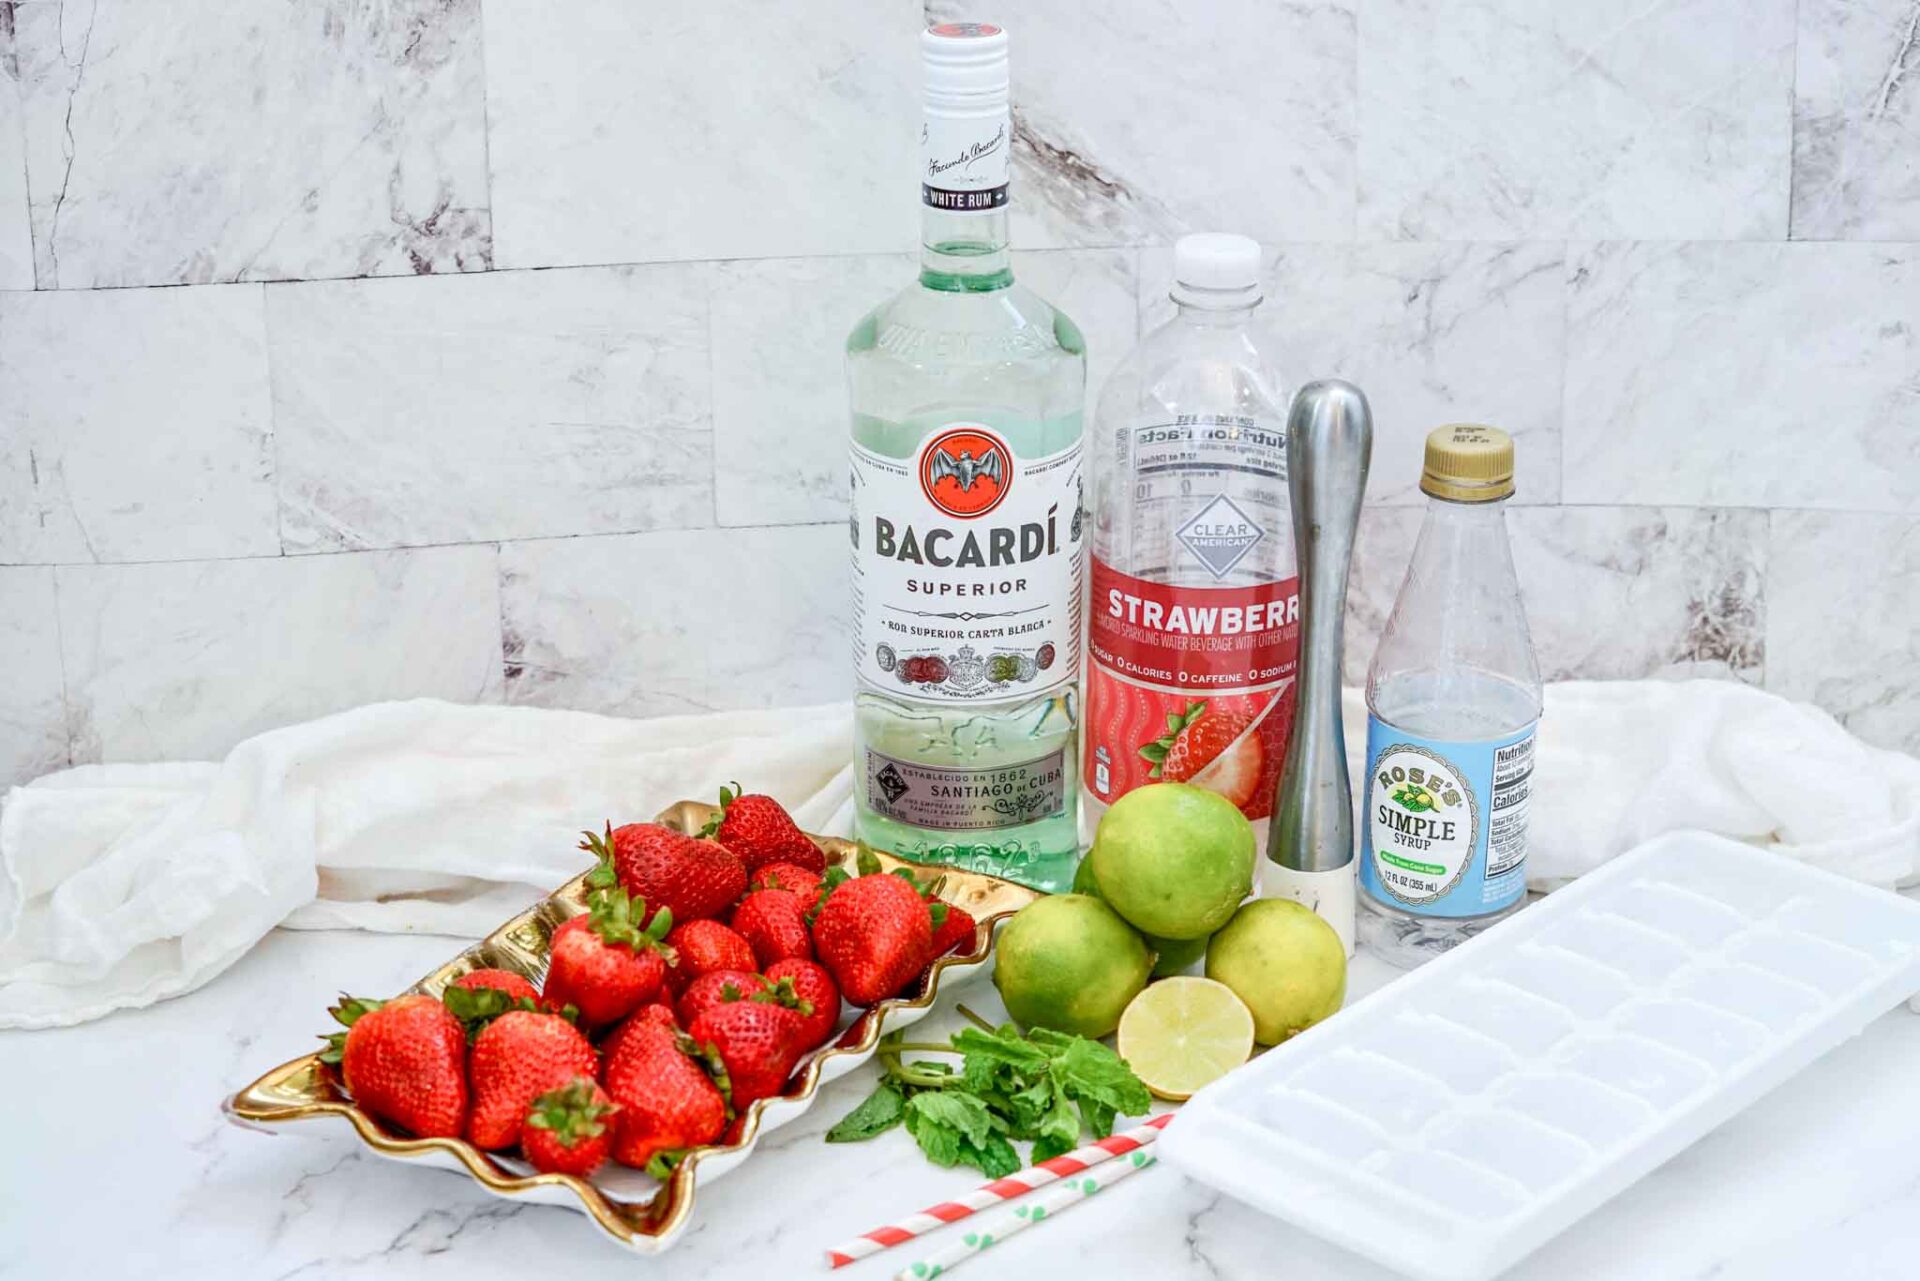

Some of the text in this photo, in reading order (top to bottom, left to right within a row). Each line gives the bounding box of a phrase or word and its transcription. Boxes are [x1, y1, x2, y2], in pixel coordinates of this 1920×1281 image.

[930, 189, 992, 207] WHITE RUM
[876, 501, 1058, 568] BACARDÍ
[1194, 524, 1248, 536] CLEAR
[906, 578, 1028, 596] SUPERIOR
[910, 626, 965, 640] SUPERIOR
[968, 627, 1004, 639] CARTA
[1008, 621, 1045, 637] BLANCA
[1121, 623, 1159, 646] SPARKLING
[1160, 633, 1188, 650] WATER
[1190, 636, 1233, 652] BEVERAGE
[1235, 634, 1257, 651] WITH
[1258, 630, 1282, 648] OTHER
[1125, 662, 1173, 681] CALORIES
[1178, 671, 1188, 682] 0
[1190, 672, 1243, 684] CAFFEINE
[1248, 669, 1258, 680] 0
[1259, 661, 1293, 679] SODIUM
[901, 767, 969, 783] ESTABLECIDO
[990, 768, 1027, 784] 1862
[930, 783, 1013, 798] SANTIAGO
[1029, 767, 1061, 789] CUBA
[1378, 766, 1463, 808] ROSE'S
[1493, 785, 1529, 809] Calories
[1378, 805, 1456, 842] SIMPLE
[1394, 832, 1431, 851] SYRUP
[1384, 869, 1392, 881] 12
[1392, 873, 1399, 884] FL
[1400, 875, 1408, 887] OZ
[1409, 878, 1424, 891] (355
